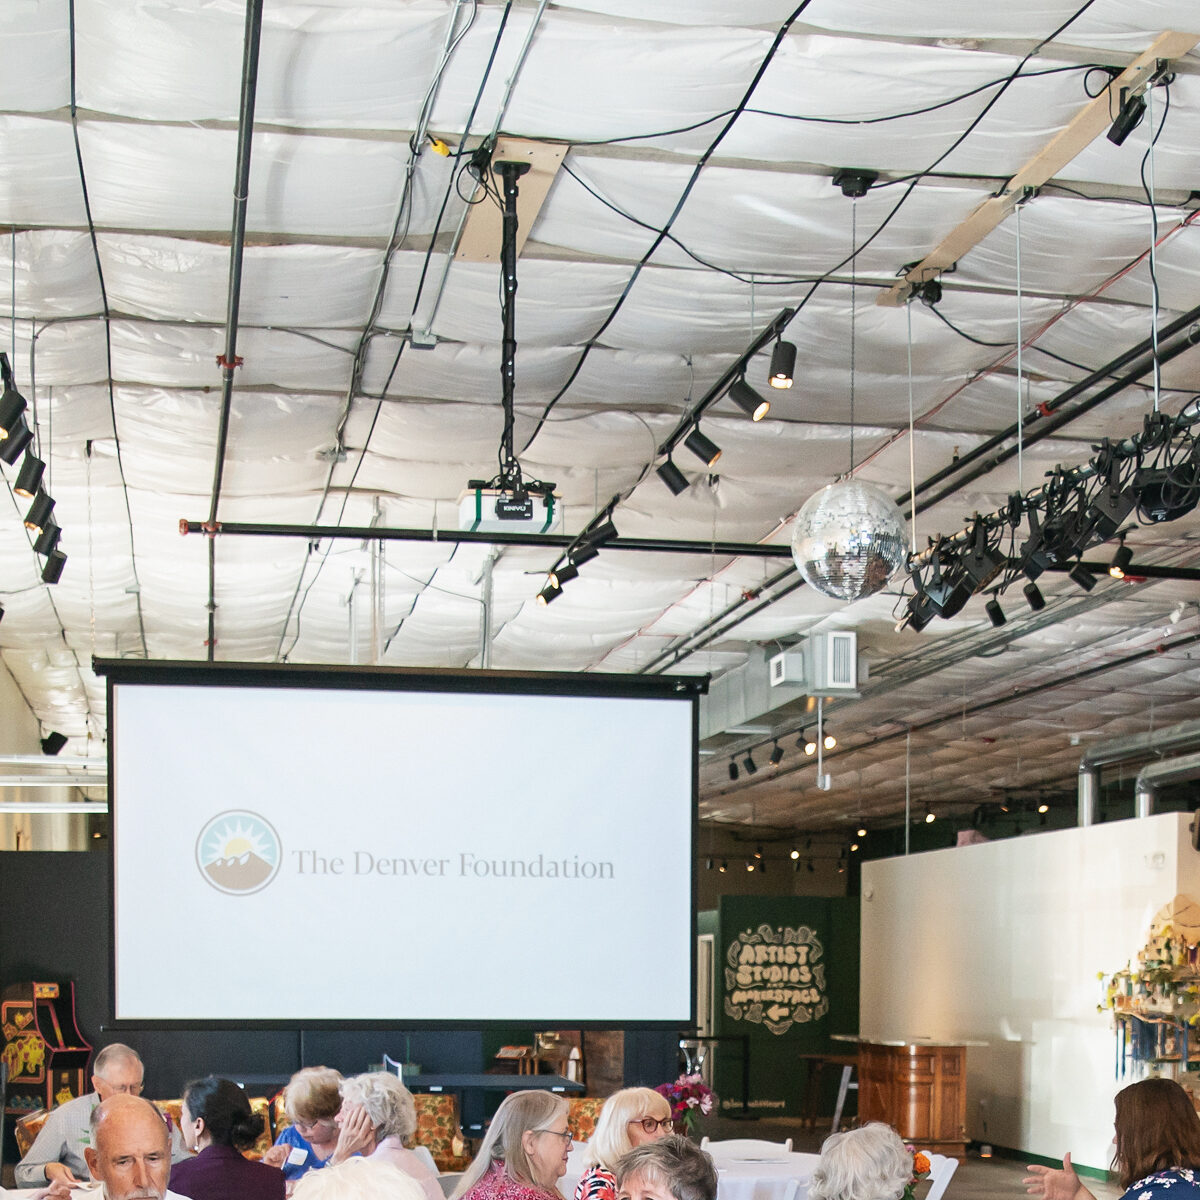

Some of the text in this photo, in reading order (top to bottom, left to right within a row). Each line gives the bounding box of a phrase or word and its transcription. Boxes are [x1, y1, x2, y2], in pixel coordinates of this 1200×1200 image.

[291, 849, 616, 879] The Denver Foundation
[739, 944, 809, 965] ARTIST
[736, 964, 812, 985] STUDIOS
